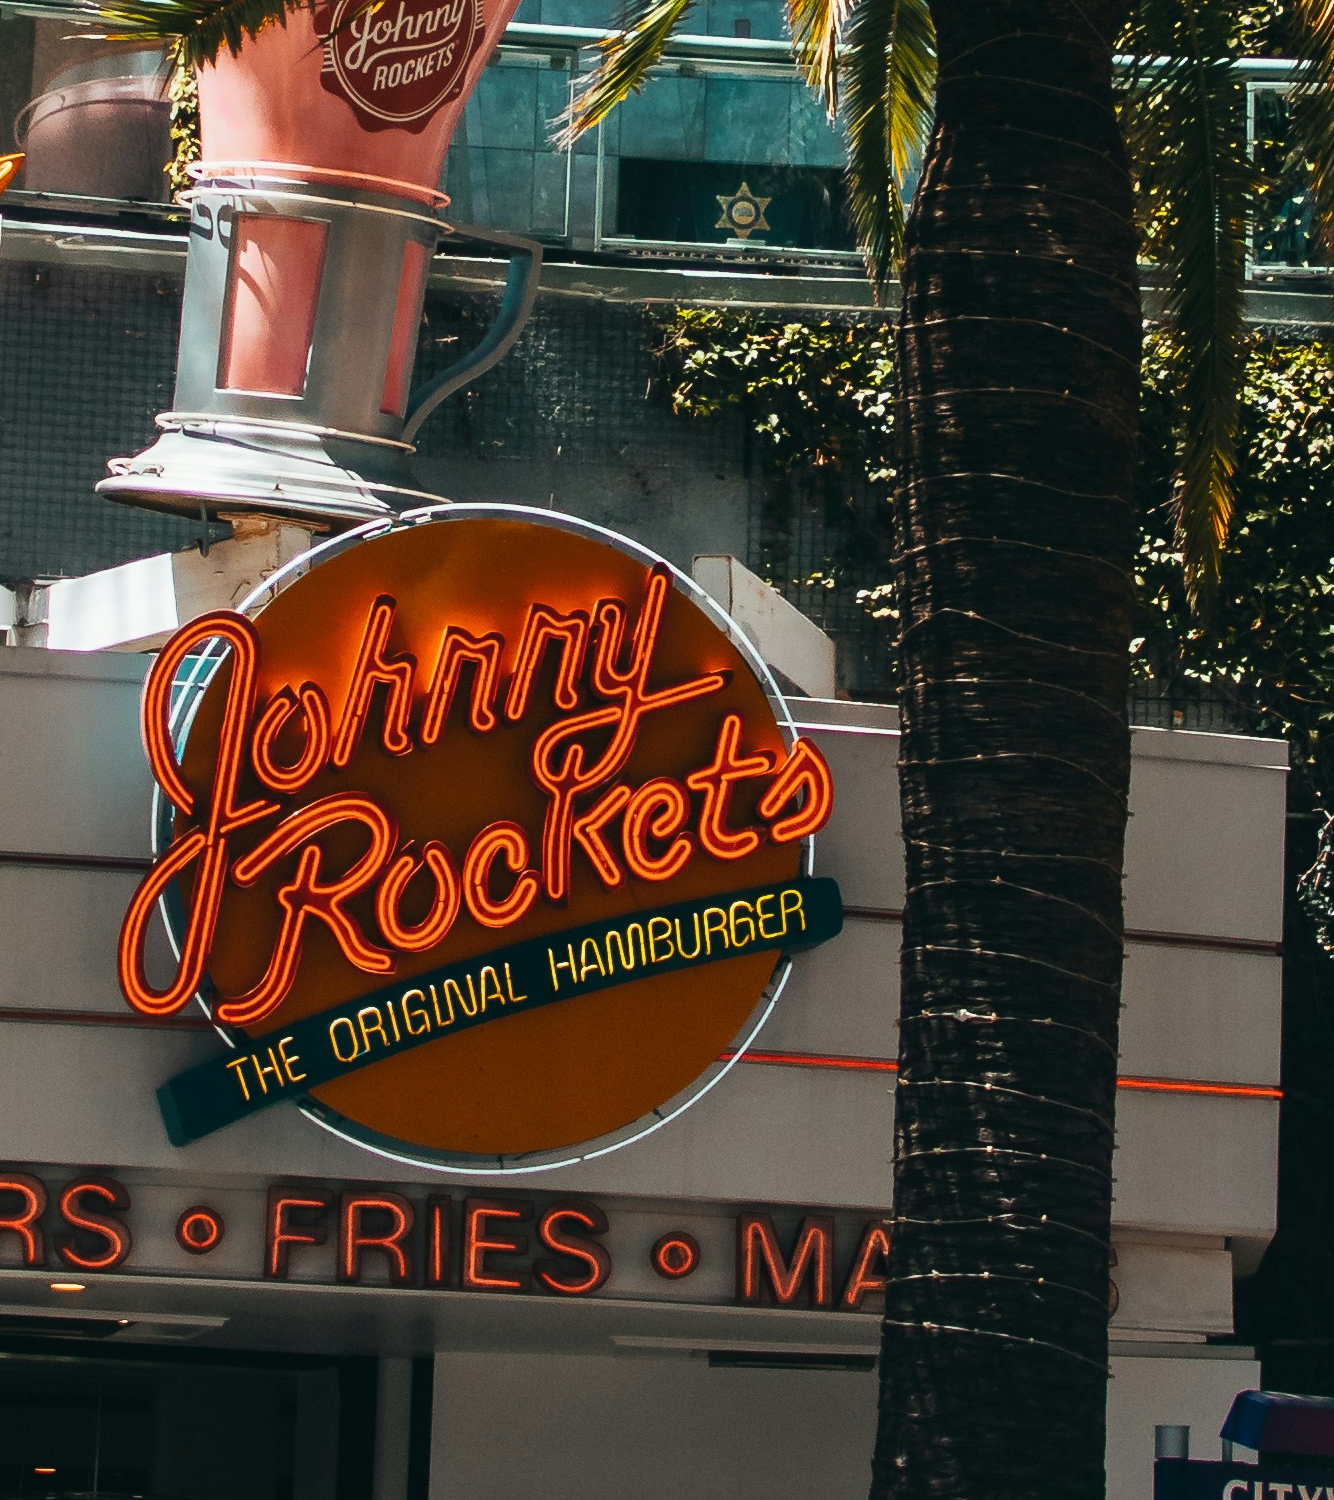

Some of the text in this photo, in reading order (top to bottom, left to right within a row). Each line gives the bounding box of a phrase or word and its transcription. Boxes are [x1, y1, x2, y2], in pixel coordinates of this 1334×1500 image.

[373, 43, 455, 91] ROCKETS
[117, 561, 734, 1017] Johnny
[213, 714, 835, 1025] Rockets
[225, 888, 808, 1103] THE ORIGINAL HAMBURGER
[265, 1186, 613, 1295] FRIES
